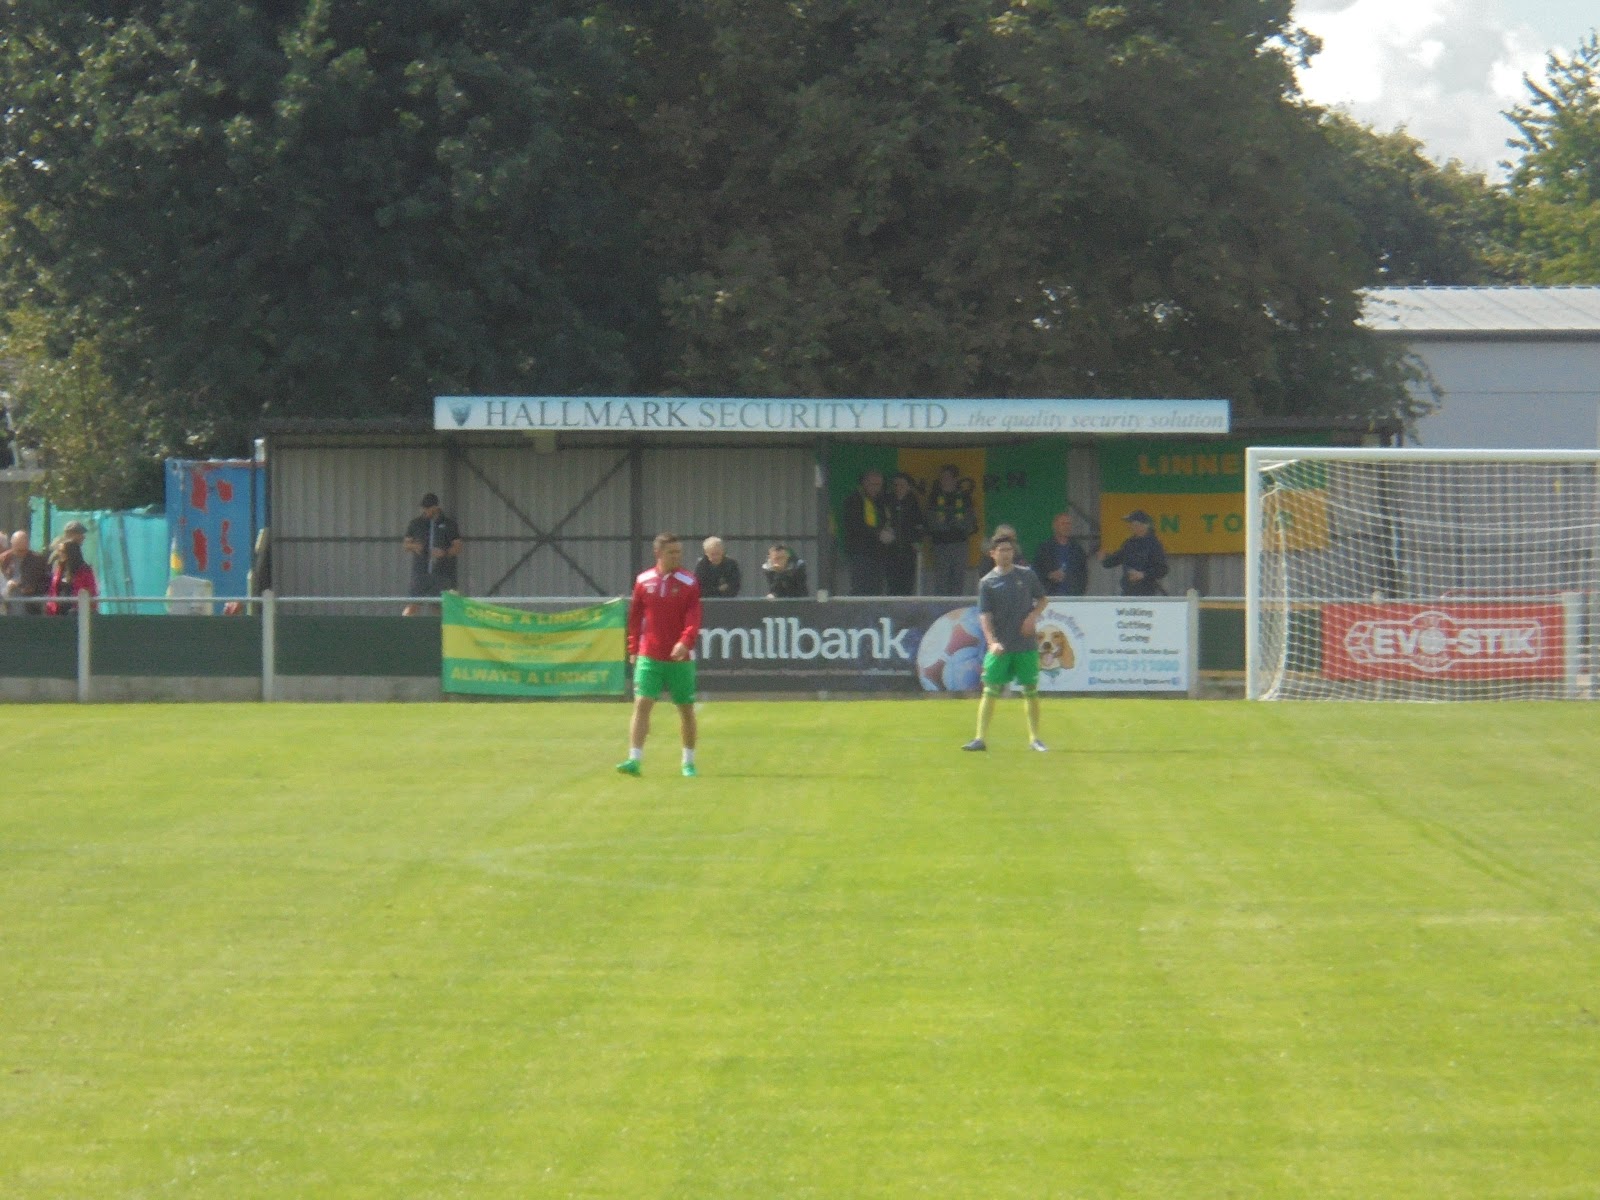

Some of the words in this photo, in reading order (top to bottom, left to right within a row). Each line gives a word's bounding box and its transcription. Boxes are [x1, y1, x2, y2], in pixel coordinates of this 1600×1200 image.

[486, 401, 689, 427] HALLMARK
[699, 401, 870, 428] SECURITY
[882, 402, 948, 430] LTD
[1002, 410, 1065, 432] quality
[1071, 411, 1143, 432] security
[1151, 411, 1224, 429] solution
[1138, 453, 1240, 475] LINNE
[699, 617, 910, 660] millbank
